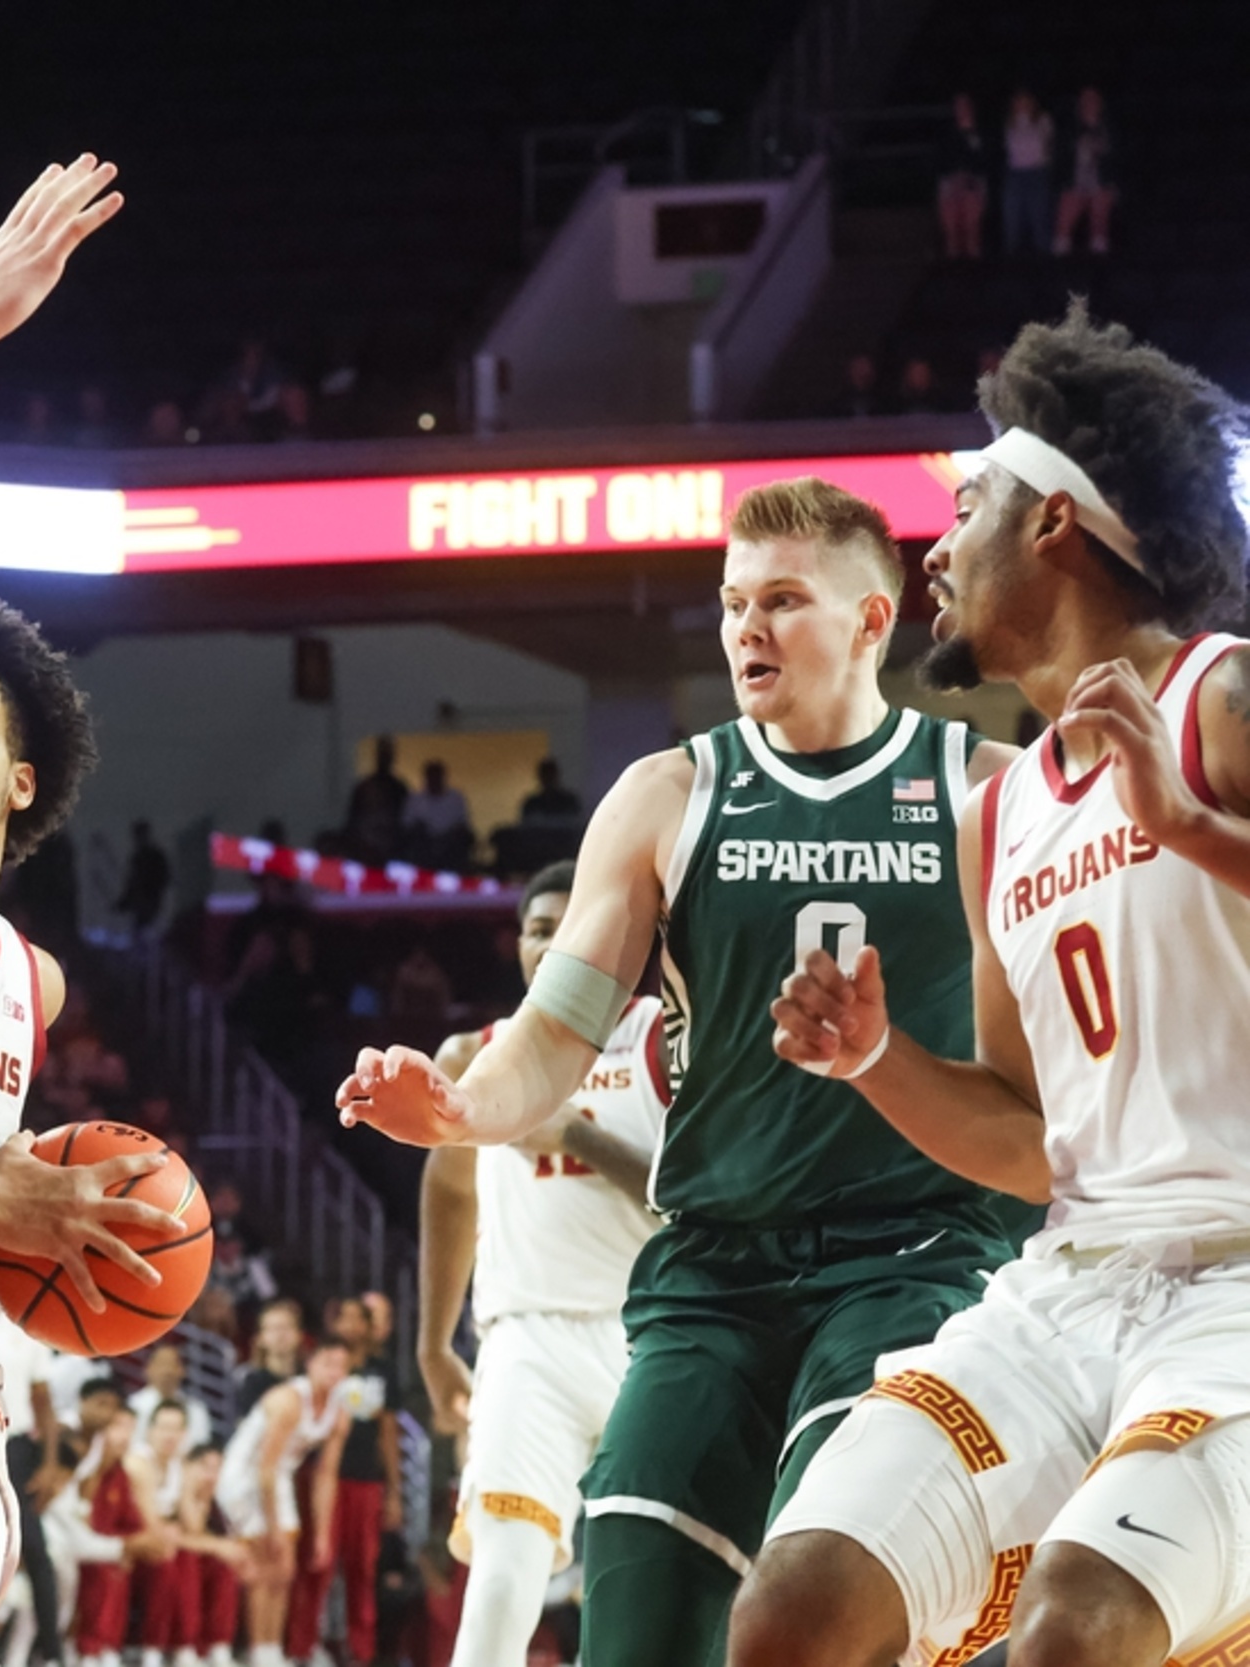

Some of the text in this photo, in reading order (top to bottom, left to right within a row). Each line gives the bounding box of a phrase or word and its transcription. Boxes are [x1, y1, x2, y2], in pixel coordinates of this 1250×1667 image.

[409, 470, 723, 550] FIGHT ON!
[730, 771, 755, 788] JF
[717, 839, 942, 884] SPARTANS
[1002, 823, 1160, 933] TROJANS
[1053, 920, 1121, 1062] 0
[580, 1067, 632, 1091] NS
